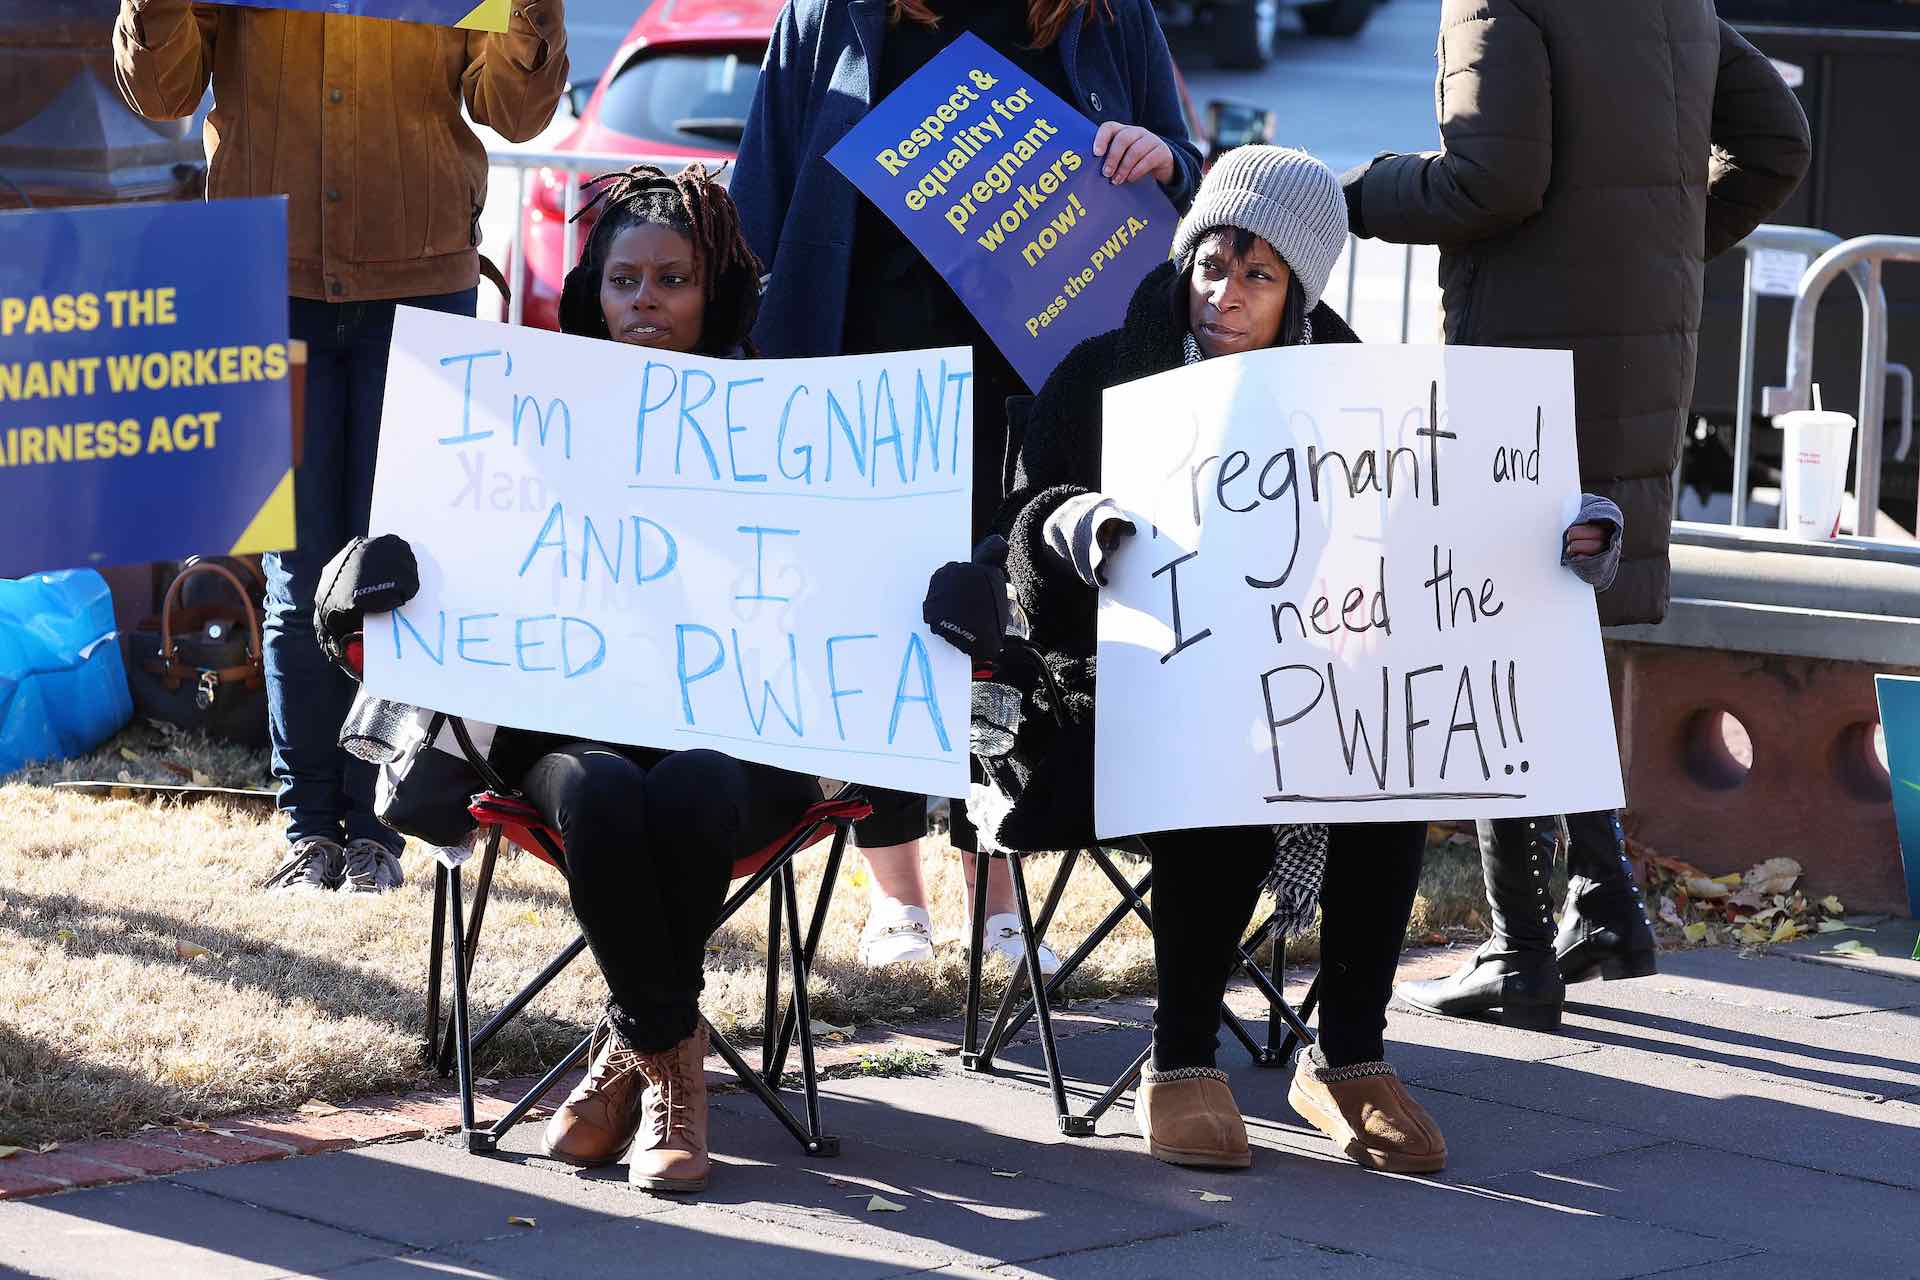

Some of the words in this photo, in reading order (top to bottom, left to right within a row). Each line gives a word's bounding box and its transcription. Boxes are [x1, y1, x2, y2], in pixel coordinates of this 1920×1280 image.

[876, 85, 979, 176] Respect
[967, 67, 1000, 92] &
[905, 115, 1004, 211] equality
[991, 86, 1035, 121] for
[944, 118, 1058, 234] pregnant
[977, 150, 1082, 253] workers
[1020, 192, 1088, 268] now!
[1, 293, 100, 336] PASS
[105, 287, 177, 328] THE
[1024, 294, 1069, 338] Pass
[1063, 266, 1095, 299] the
[1089, 215, 1150, 272] PWFA.
[106, 343, 288, 394] WORKERS
[438, 349, 572, 460] I'm
[634, 358, 972, 487] PREGNANT
[0, 420, 142, 467] IRNESS
[146, 411, 222, 455] ACT
[1492, 405, 1545, 486] and
[518, 501, 680, 586] AND
[734, 524, 801, 602] I
[1151, 550, 1213, 665] I
[1271, 555, 1392, 644] need
[1423, 544, 1505, 632] the
[391, 608, 608, 680] NEED
[674, 622, 953, 754] PWFA
[1258, 659, 1531, 793] PWFA!!
